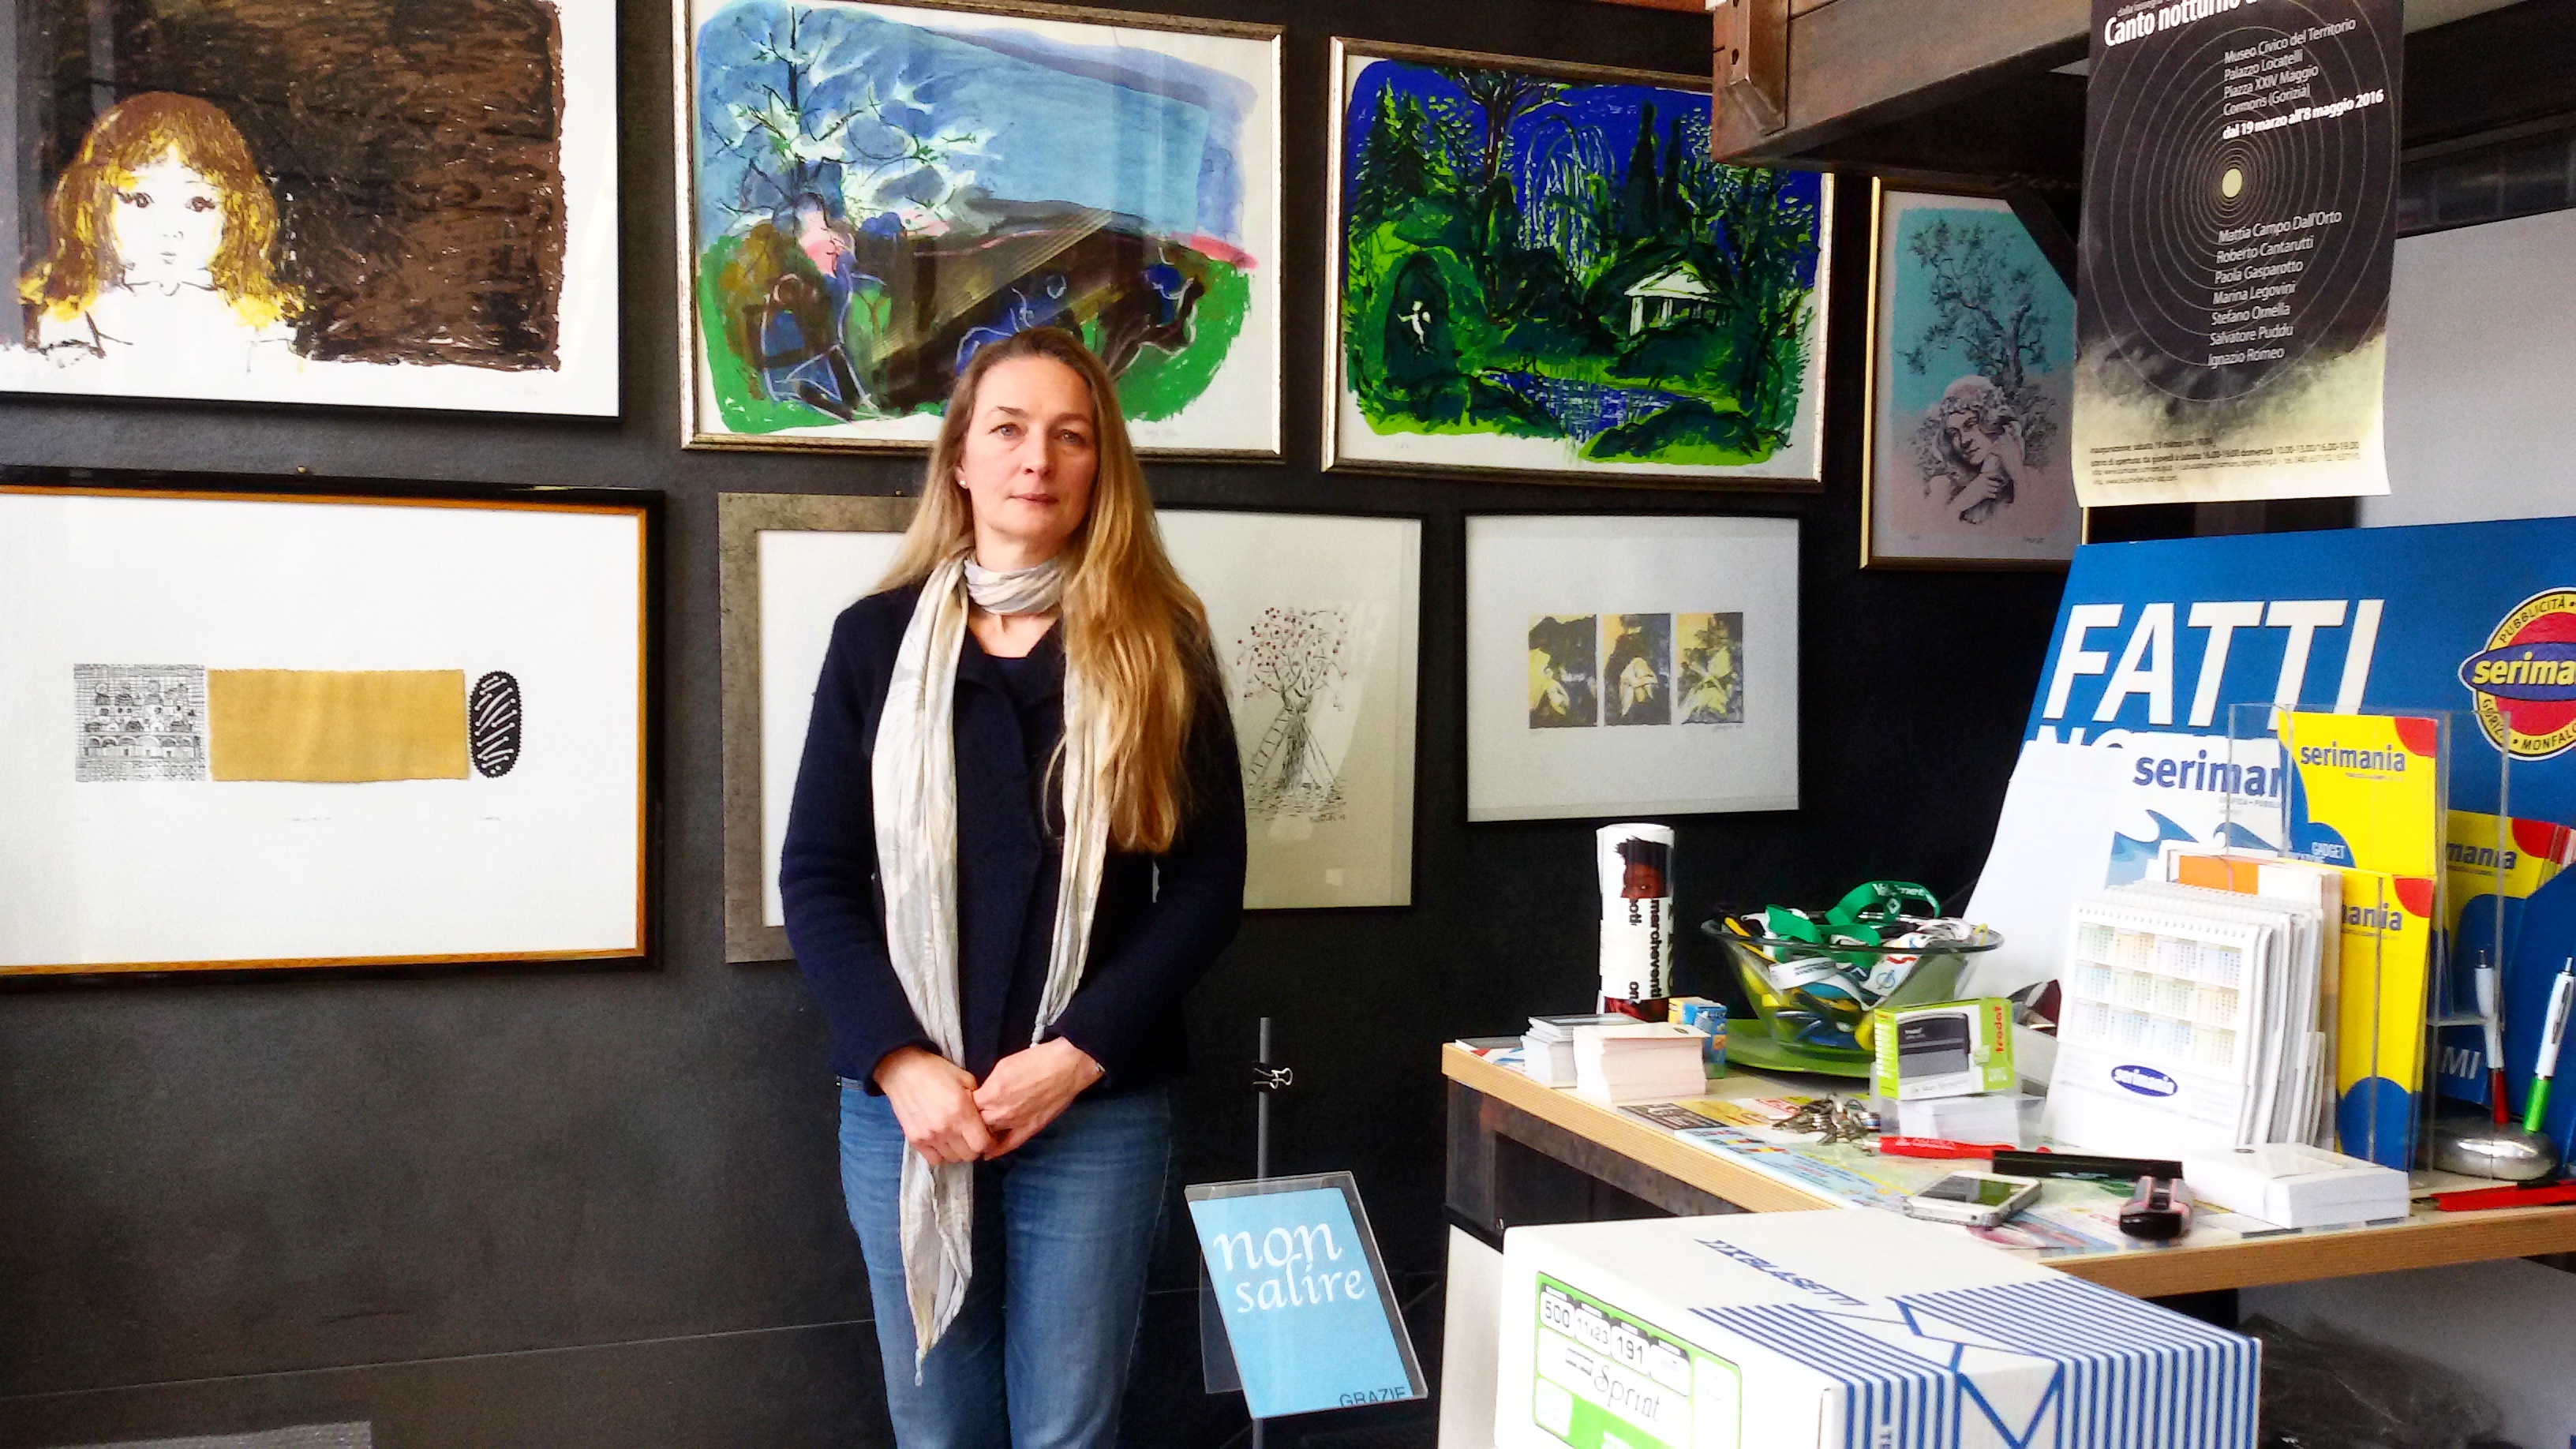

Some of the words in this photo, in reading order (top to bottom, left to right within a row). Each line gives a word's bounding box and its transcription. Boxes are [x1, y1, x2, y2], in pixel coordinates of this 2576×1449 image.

[2104, 12, 2155, 47] Canto
[2225, 47, 2256, 64] Museo
[2258, 38, 2289, 54] Civico
[2290, 29, 2306, 47] del
[2308, 18, 2357, 41] Territorio
[2224, 63, 2260, 81] Palazzo
[2261, 48, 2304, 71] Locatelli
[2224, 82, 2253, 99] Piazza
[2255, 75, 2278, 91] XXIV
[2279, 65, 2320, 84] Maggio
[2222, 124, 2240, 140] dal
[2241, 121, 2255, 135] 19
[2255, 115, 2288, 132] marzo
[2288, 107, 2312, 124] all'8
[2312, 99, 2354, 118] maggio
[2354, 88, 2385, 107] 2016
[2223, 96, 2267, 116] Cormons
[2268, 83, 2311, 106] (Gorizia)
[2218, 225, 2252, 243] Mattia
[2252, 220, 2291, 237] Campo
[2293, 211, 2343, 230] Dall'Orto
[2215, 246, 2258, 264] Roberto
[2259, 235, 2315, 256] Cantarutti
[2214, 267, 2242, 284] Paola
[2244, 260, 2304, 279] Gasparotto
[2212, 288, 2248, 305] Marina
[2249, 280, 2296, 301] Legovini
[2211, 309, 2250, 326] Stefano
[2209, 331, 2257, 346] Salvatore
[2258, 323, 2294, 339] Puddu
[2208, 350, 2245, 369] Ignazio
[2246, 346, 2286, 362] Romeo
[2042, 598, 2385, 730] FATTI
[2300, 741, 2406, 772] serimania
[1213, 1223, 1342, 1271] non
[1234, 1253, 1365, 1313] salire
[1544, 1299, 1571, 1329] 500
[1616, 1335, 1643, 1365] 191
[1593, 1365, 1661, 1423] Sprint
